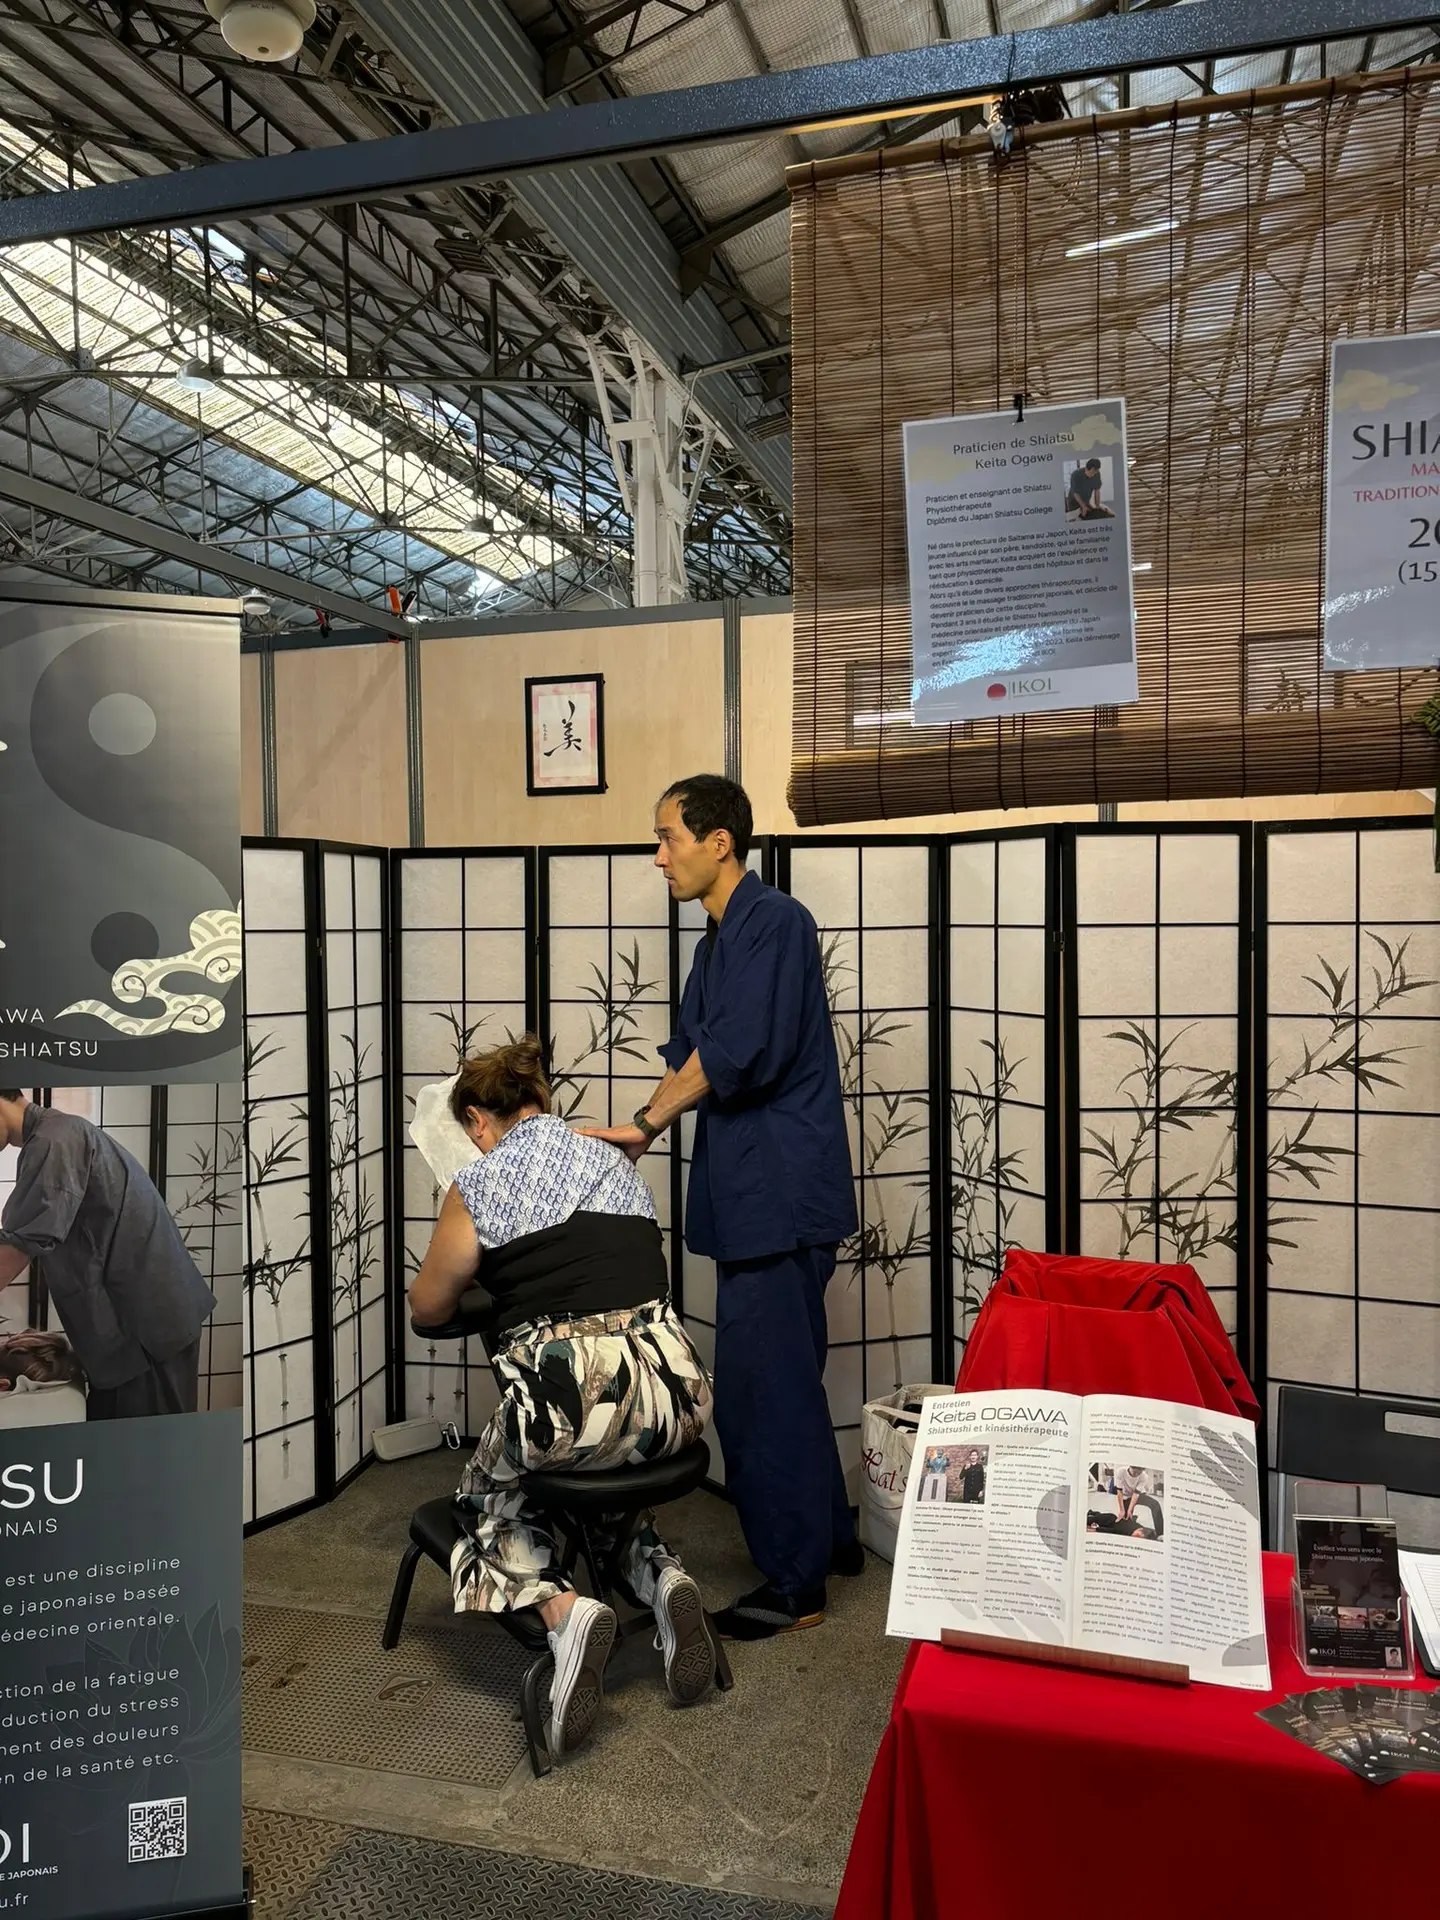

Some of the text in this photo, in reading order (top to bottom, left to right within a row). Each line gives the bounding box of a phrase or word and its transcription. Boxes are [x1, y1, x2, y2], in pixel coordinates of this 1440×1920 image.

[953, 431, 1074, 455] Praticien de Shiatsu
[975, 451, 1053, 469] Keita Ogawa
[925, 493, 958, 504] Praticien
[969, 487, 1010, 500] enseignant
[1011, 486, 1022, 494] de
[1023, 483, 1051, 493] Shiatsu
[926, 500, 991, 516] Physiothérapeute
[959, 514, 968, 522] du
[970, 511, 993, 523] Japan
[994, 508, 1022, 518] Shiatsu
[1024, 505, 1052, 517] College
[1398, 560, 1438, 586] (15
[1012, 678, 1052, 694] IKOI
[0, 1040, 98, 1058] SHIATSU
[932, 1400, 970, 1410] Entretien
[930, 1408, 1068, 1425] Keita OGAWA
[928, 1422, 972, 1435] Shiatsushi
[986, 1424, 1069, 1438] kinésithérapeute
[0, 1458, 84, 1510] SU
[0, 1518, 58, 1537] NAIS
[5, 1557, 180, 1587] est une discipline
[20, 1592, 116, 1616] japonaise
[124, 1584, 180, 1601] basée
[1, 1612, 180, 1643] édecine orientale.
[52, 1679, 76, 1694] de
[84, 1676, 100, 1690] la
[108, 1668, 180, 1686] fatigue
[2, 1698, 180, 1728] duction du stress
[50, 1736, 84, 1751] des
[93, 1725, 180, 1744] douleurs
[24, 1752, 180, 1782] de la santé etc.
[8, 1866, 58, 1880] JAPONAIS
